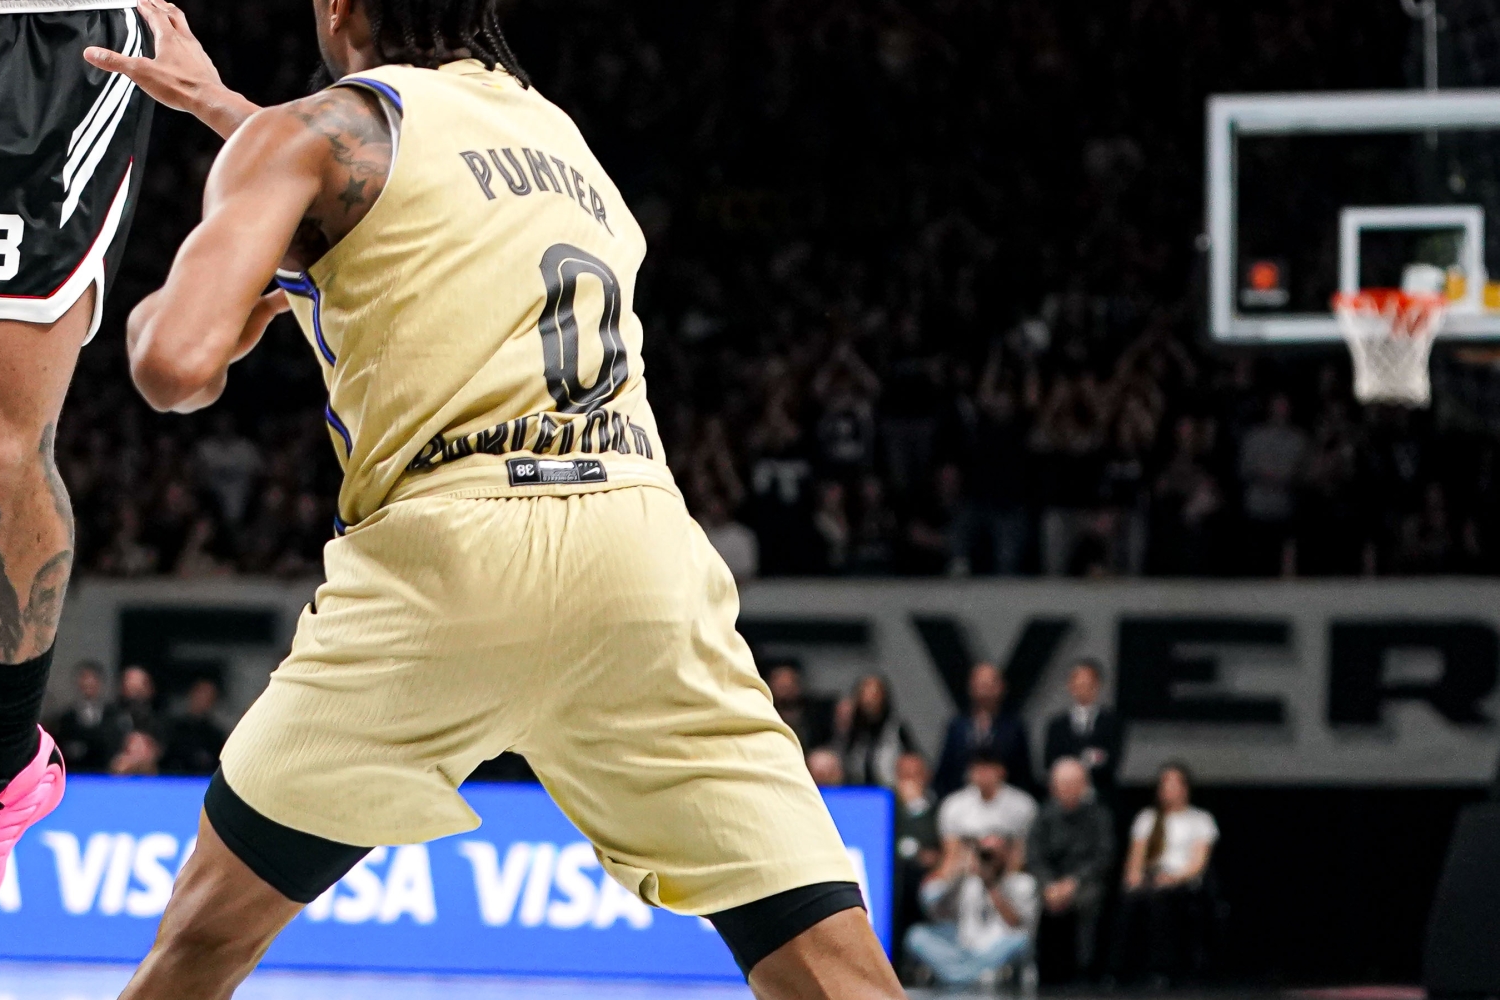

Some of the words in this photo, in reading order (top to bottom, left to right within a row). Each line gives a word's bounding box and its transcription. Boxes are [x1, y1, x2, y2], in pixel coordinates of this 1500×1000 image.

[460, 147, 614, 237] PUNTER
[538, 243, 629, 414] 0
[42, 831, 198, 917] VIS
